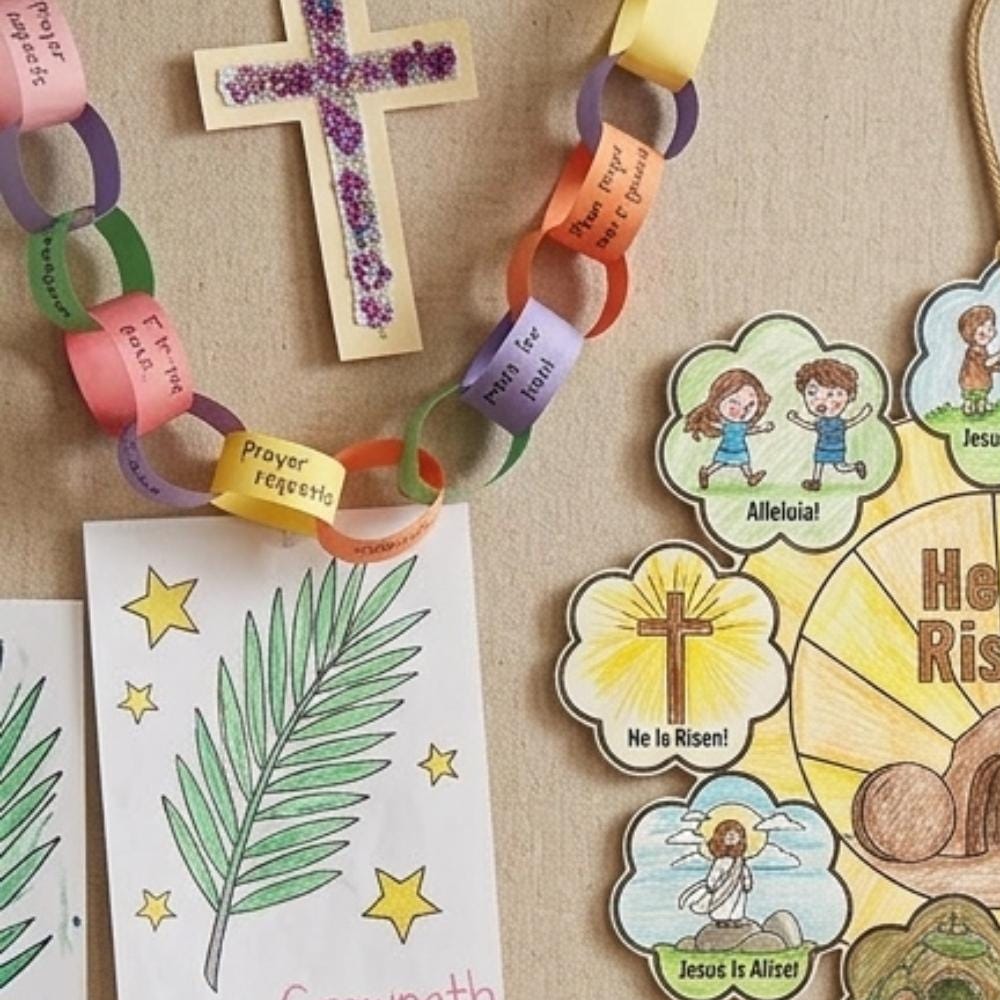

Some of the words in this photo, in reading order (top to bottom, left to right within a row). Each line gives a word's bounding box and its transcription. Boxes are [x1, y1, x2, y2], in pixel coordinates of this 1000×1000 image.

[921, 548, 999, 611] He
[627, 728, 651, 748] He
[674, 728, 728, 748] Risen!
